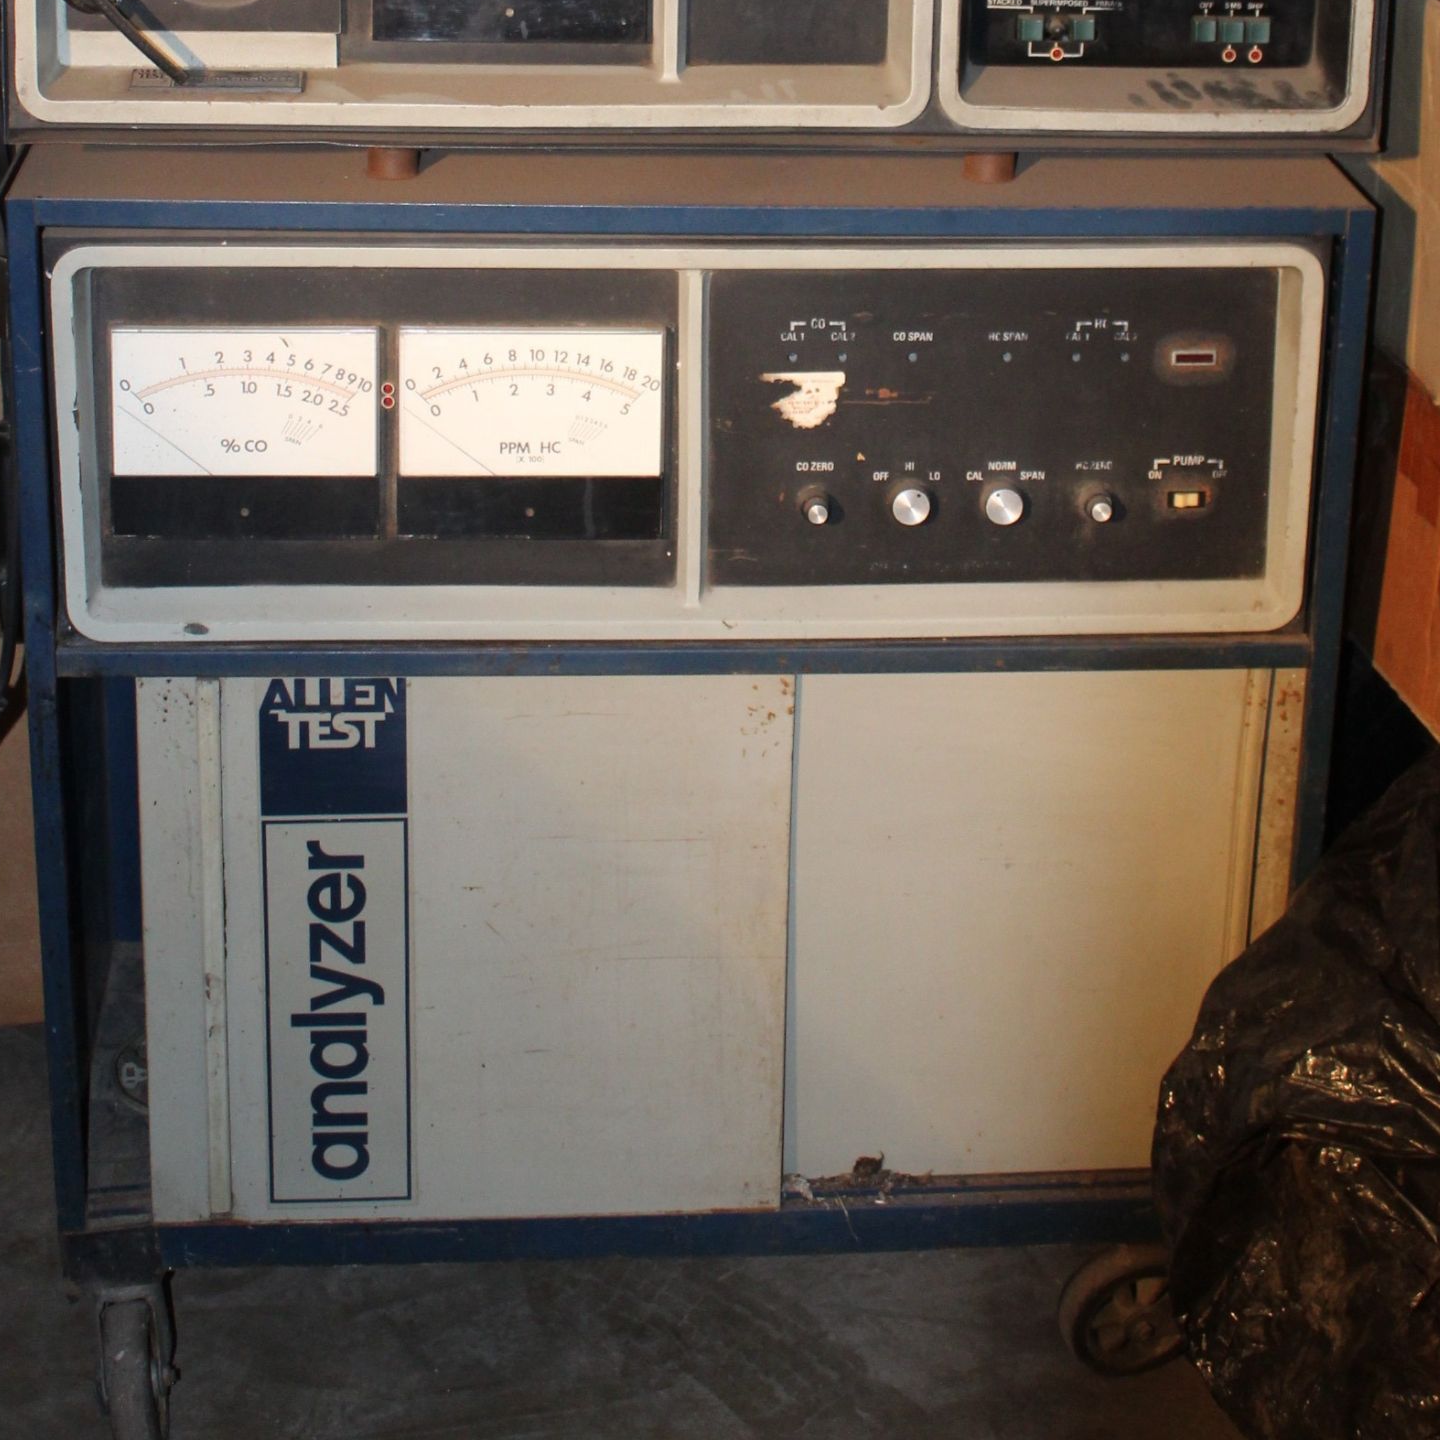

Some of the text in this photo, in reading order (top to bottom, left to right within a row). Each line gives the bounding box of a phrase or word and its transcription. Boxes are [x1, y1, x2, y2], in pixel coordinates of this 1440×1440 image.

[811, 318, 826, 330] CO
[781, 332, 798, 342] CAL
[831, 332, 849, 342] CAL
[893, 332, 933, 342] CO SPAN
[119, 350, 373, 392] 0 1 2 3 4 5 6 7 8 9 10
[405, 349, 660, 392] 0 2 4 6 8 10 12 14 16 18 20
[143, 401, 155, 415] 0
[241, 381, 257, 394] 1.0
[276, 384, 293, 399] 1.5
[302, 389, 324, 406] 2.0
[328, 399, 350, 417] 2.5
[430, 384, 632, 417] 0 1 2 3 4 5
[220, 438, 268, 453] % CO
[500, 441, 561, 454] PPM HC
[1173, 456, 1204, 466] PUMP
[796, 462, 835, 472] CO ZERO
[905, 462, 915, 471] HI
[988, 462, 1017, 471] NORM
[873, 472, 889, 481] OFF
[929, 472, 940, 481] LO
[966, 472, 984, 481] CAL
[1020, 471, 1045, 480] SPAN
[1148, 470, 1162, 480] ON
[260, 678, 406, 713] ALLEN
[278, 711, 386, 749] TEST
[290, 839, 386, 1182] analyzer
